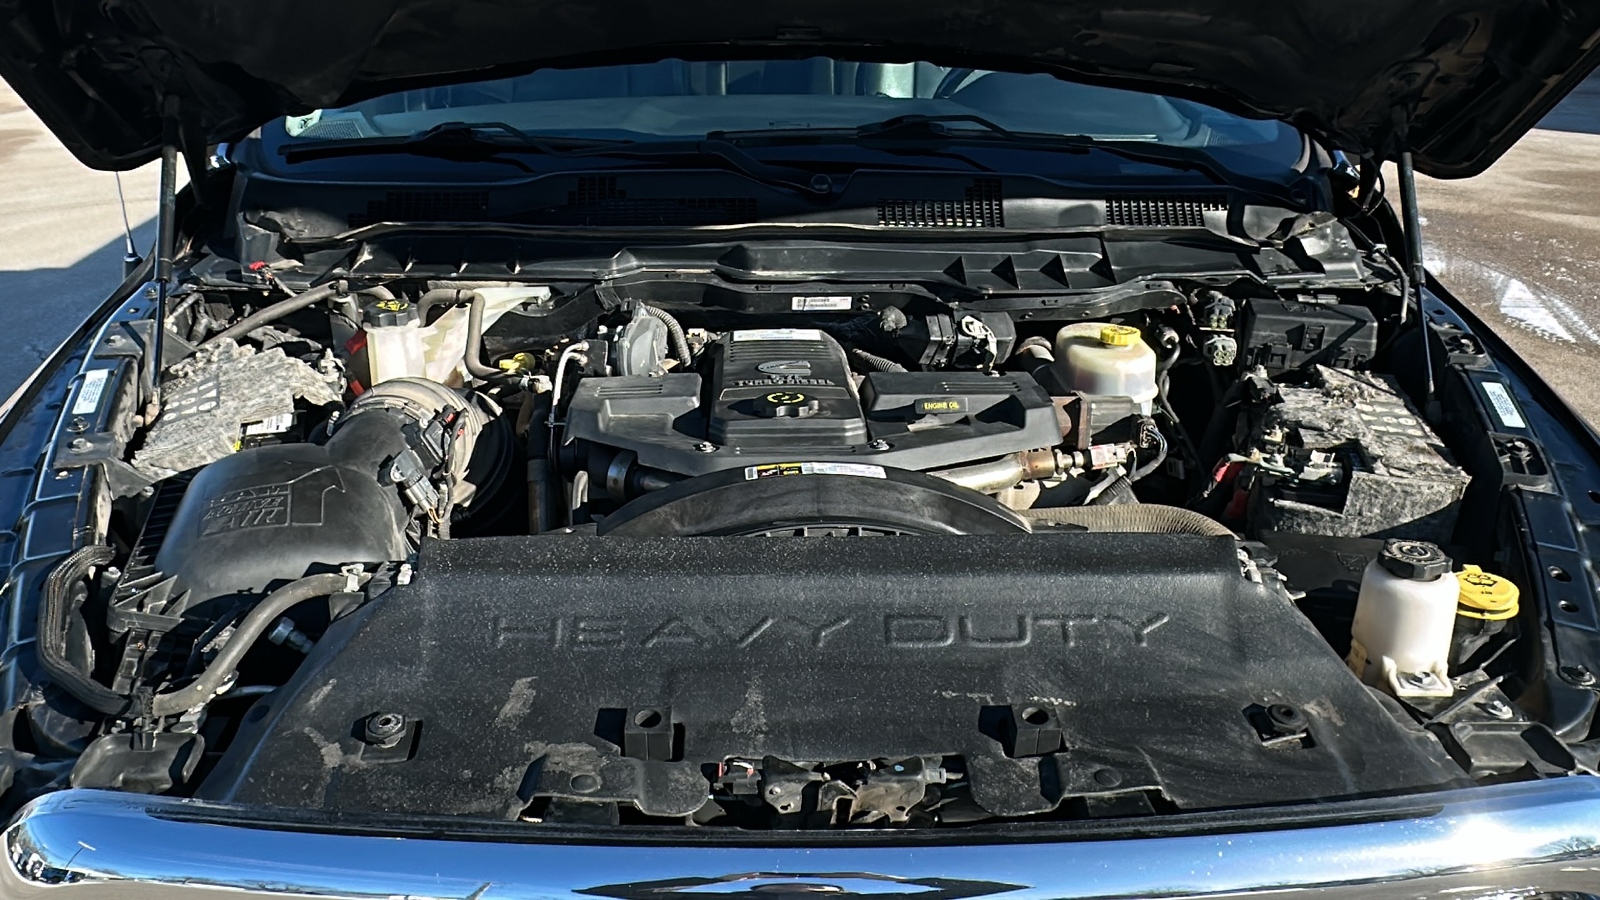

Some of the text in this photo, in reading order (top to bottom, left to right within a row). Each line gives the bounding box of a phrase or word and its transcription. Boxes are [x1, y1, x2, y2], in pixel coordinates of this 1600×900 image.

[923, 401, 960, 410] ENGINE OIL
[494, 613, 1170, 650] HEAVY DUTY
